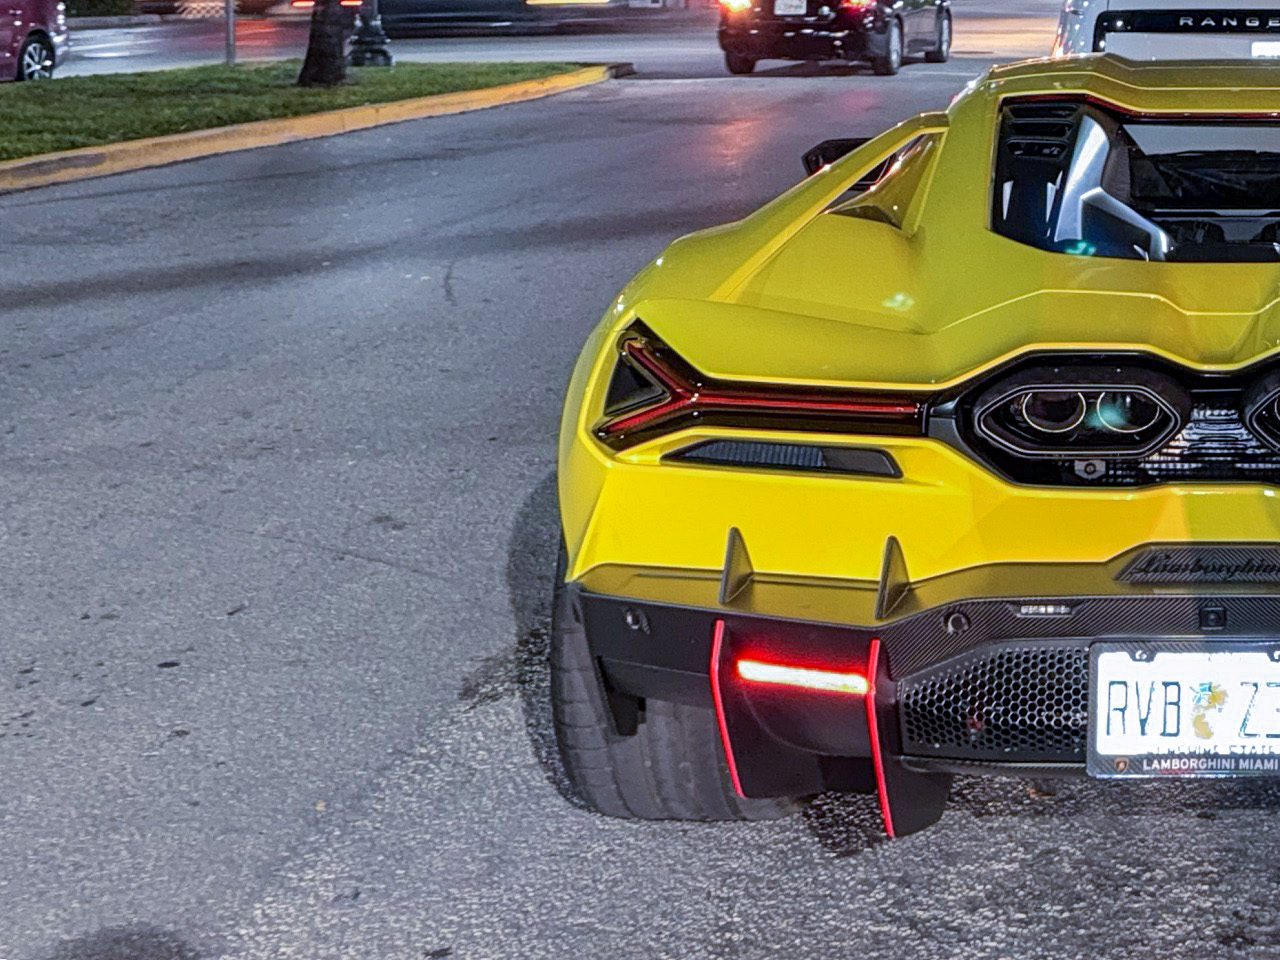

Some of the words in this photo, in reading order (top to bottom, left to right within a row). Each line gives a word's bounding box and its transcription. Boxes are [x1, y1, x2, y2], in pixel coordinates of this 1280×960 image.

[1179, 16, 1280, 27] RANGE
[1106, 680, 1182, 738] RVB
[1143, 757, 1235, 771] LAMBORGHINI
[1238, 758, 1279, 771] MIAMI
